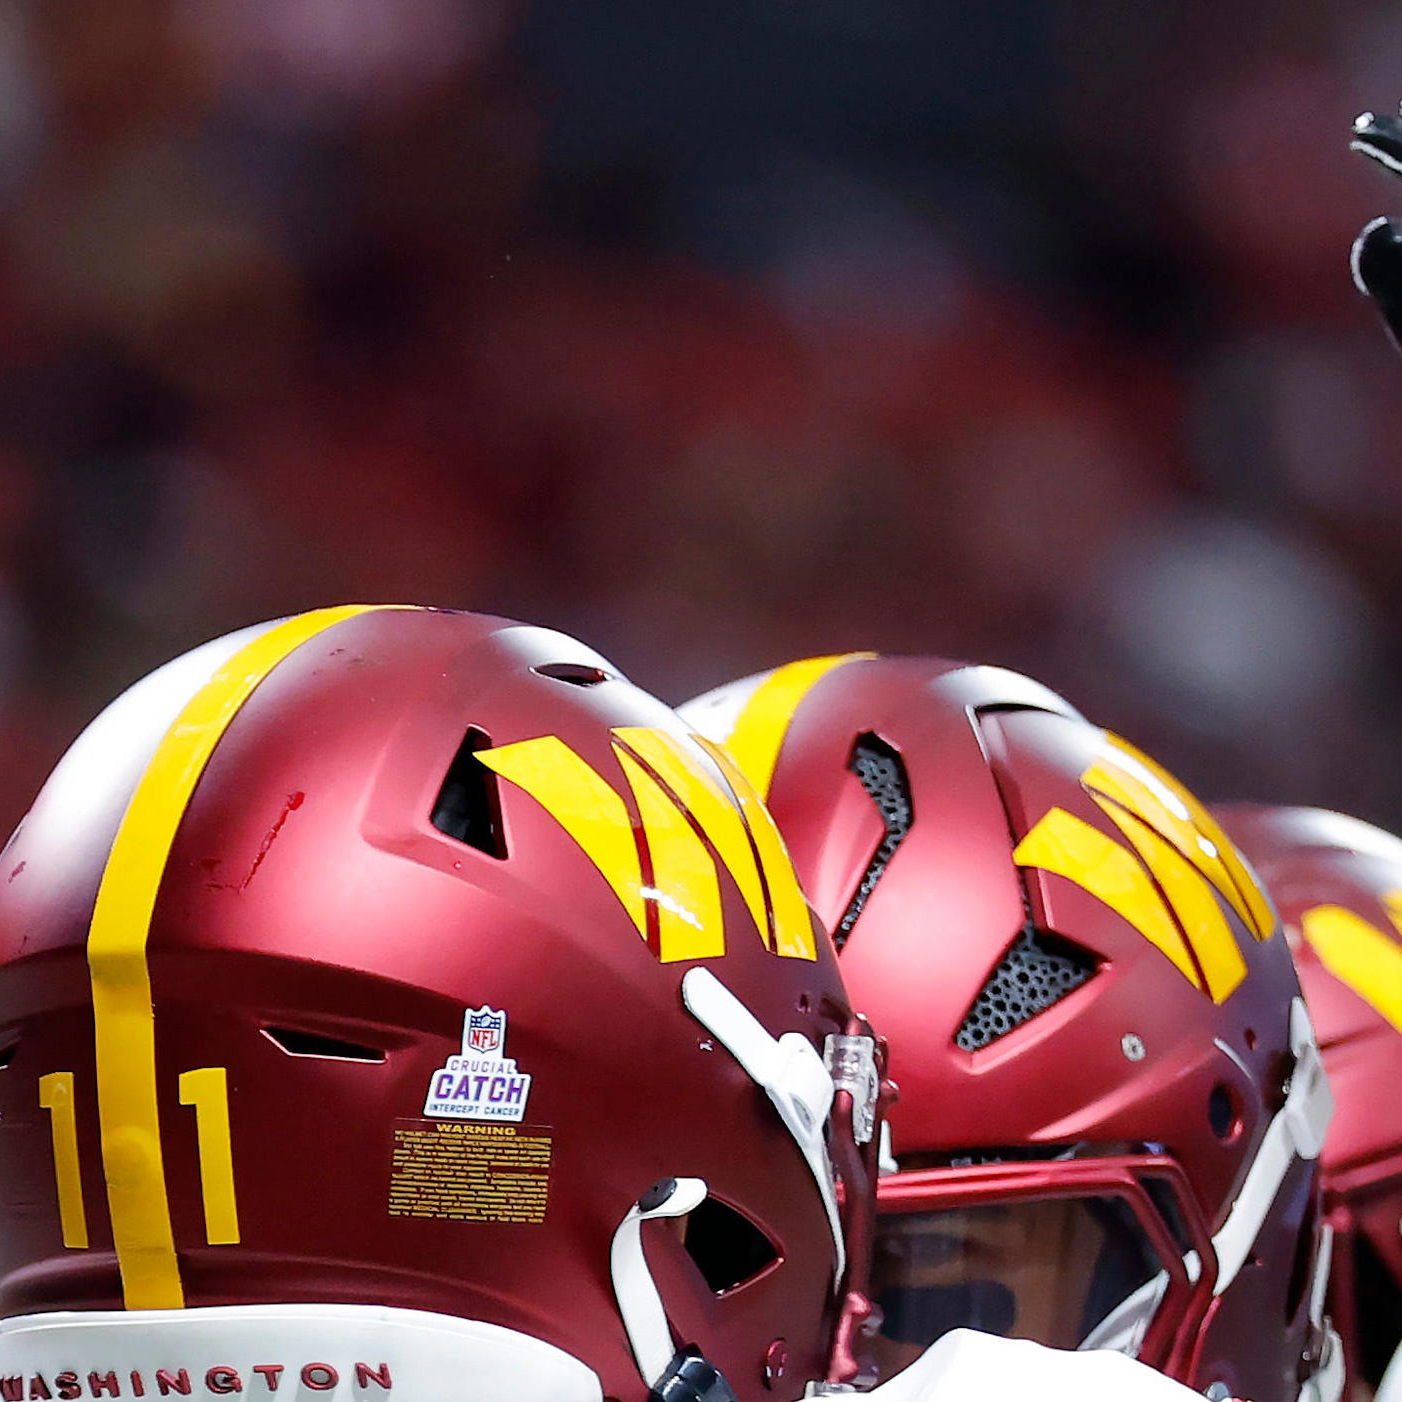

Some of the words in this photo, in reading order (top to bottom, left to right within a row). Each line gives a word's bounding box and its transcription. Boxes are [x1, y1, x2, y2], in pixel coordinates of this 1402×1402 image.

[470, 1029, 498, 1048] NFL
[451, 1059, 513, 1075] CRUCIAL
[435, 1073, 526, 1104] CATCH
[428, 1103, 479, 1114] INTERCEPT
[484, 1106, 520, 1117] CANCER
[436, 1123, 517, 1136] WARNING
